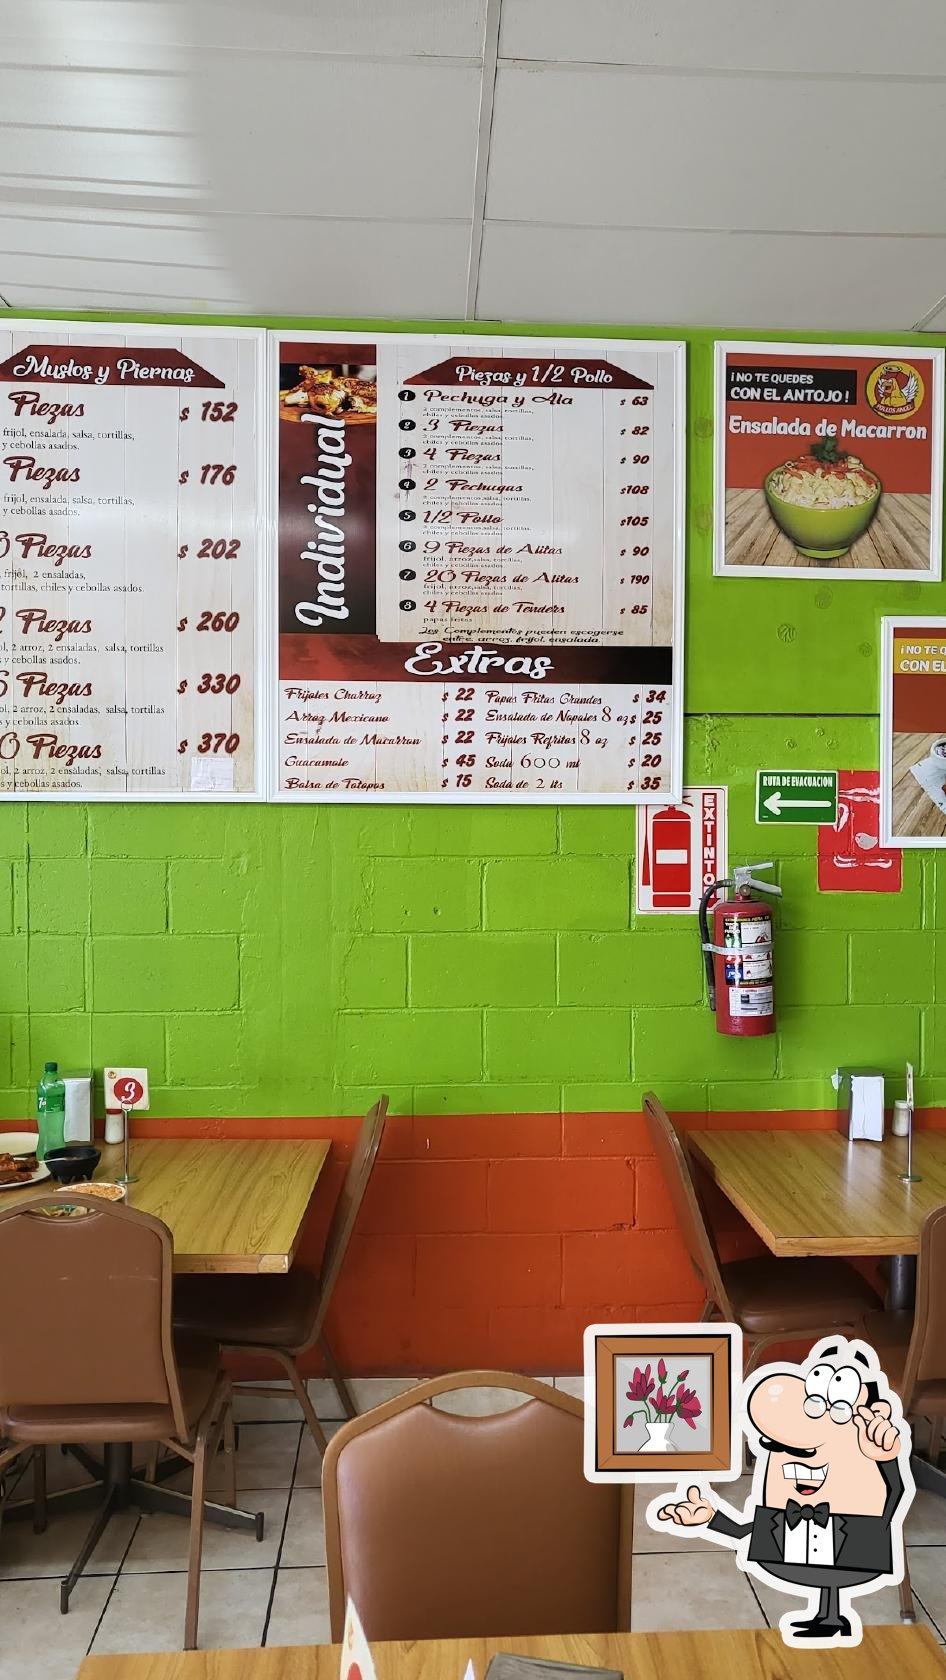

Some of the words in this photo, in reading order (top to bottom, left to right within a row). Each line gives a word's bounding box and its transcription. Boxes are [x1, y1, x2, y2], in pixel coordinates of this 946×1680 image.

[13, 356, 93, 380] Muslos
[95, 365, 110, 384] y
[117, 358, 195, 382] Piernas
[455, 365, 512, 386] Piezas
[514, 372, 527, 387] y
[532, 364, 565, 383] 1/2
[570, 367, 613, 384] Pollo
[755, 373, 769, 383] TE
[771, 373, 814, 385] QUEDES
[423, 389, 508, 407] Pechuga
[512, 397, 525, 408] y
[532, 392, 573, 405] Ala
[631, 396, 649, 405] 63
[730, 386, 761, 400] CON
[763, 388, 780, 401] EL
[8, 390, 85, 424] Piezas
[201, 401, 239, 422] 152
[423, 419, 440, 431] 3
[448, 420, 504, 435] Piezas
[631, 426, 650, 436] 82
[729, 415, 811, 436] Ensalada
[815, 418, 837, 437] de
[841, 419, 927, 440] Macarron
[10, 441, 46, 450] cebollas
[423, 448, 437, 461] 4
[445, 448, 501, 464] Piezas
[633, 455, 650, 465] 90
[3, 456, 81, 490] Piezas
[200, 464, 237, 485] 176
[424, 478, 438, 490] 2
[445, 479, 523, 495] Pechugas
[10, 506, 46, 515] cebollas
[423, 509, 453, 524] 1/2
[456, 512, 504, 524] Pollo
[295, 414, 352, 627] Individual
[15, 533, 92, 566] Piezas
[197, 538, 241, 560] 202
[423, 541, 440, 554] 9
[445, 541, 491, 557] Piezas
[496, 545, 513, 554] de
[517, 544, 562, 555] Alitas
[633, 546, 650, 557] 90
[33, 570, 39, 579] 2
[423, 570, 456, 583] 20
[461, 571, 507, 586] Piezas
[512, 573, 530, 583] de
[533, 572, 580, 583] Alitas
[630, 574, 650, 585] 190
[424, 600, 437, 613] 4
[442, 601, 488, 616] Piezas
[493, 604, 510, 613] de
[512, 602, 565, 614] Tenders
[631, 604, 648, 615] 85
[15, 608, 92, 642] Piezas
[196, 611, 240, 632] 260
[924, 645, 938, 655] TE
[11, 655, 47, 664] cebollas
[404, 641, 555, 680] Extras
[900, 660, 930, 672] CON
[15, 672, 92, 705] Piezas
[197, 673, 241, 695] 330
[284, 687, 329, 702] Frijoles
[455, 688, 475, 701] 22
[485, 690, 517, 705] Papas
[521, 691, 555, 704] Fritas
[559, 693, 602, 705] Grandes
[646, 690, 667, 703] 34
[12, 717, 48, 726] cebollas
[285, 710, 325, 725] Arroz
[328, 711, 389, 723] Mexicano
[455, 708, 475, 722] 22
[485, 709, 538, 722] Ensalada
[540, 711, 553, 722] de
[555, 709, 597, 725] Nopales
[601, 706, 612, 723] 8
[642, 711, 663, 724] 25
[284, 733, 340, 745] Ensalada
[344, 735, 357, 745] de
[360, 734, 421, 746] Macarron
[455, 730, 475, 744] 22
[485, 732, 527, 746] Frijoles
[530, 732, 576, 749] Refritos
[580, 728, 590, 745] 8
[642, 732, 662, 746] 25
[26, 734, 102, 766] Piezas
[197, 732, 240, 754] 370
[285, 755, 349, 767] Guacamole
[455, 754, 476, 768] 45
[485, 756, 513, 768] Soda
[641, 754, 662, 768] 20
[14, 779, 50, 788] cebollas
[285, 778, 324, 789] Bolsa
[326, 779, 339, 789] de
[342, 778, 385, 791] Totopos
[456, 773, 472, 787] 15
[485, 776, 513, 789] Soda
[515, 779, 528, 789] de
[536, 778, 545, 788] 2
[640, 776, 661, 790] 35
[763, 776, 780, 786] RUTA
[782, 776, 790, 786] DE
[791, 776, 833, 787] EVACUACION
[121, 1081, 136, 1101] 3
